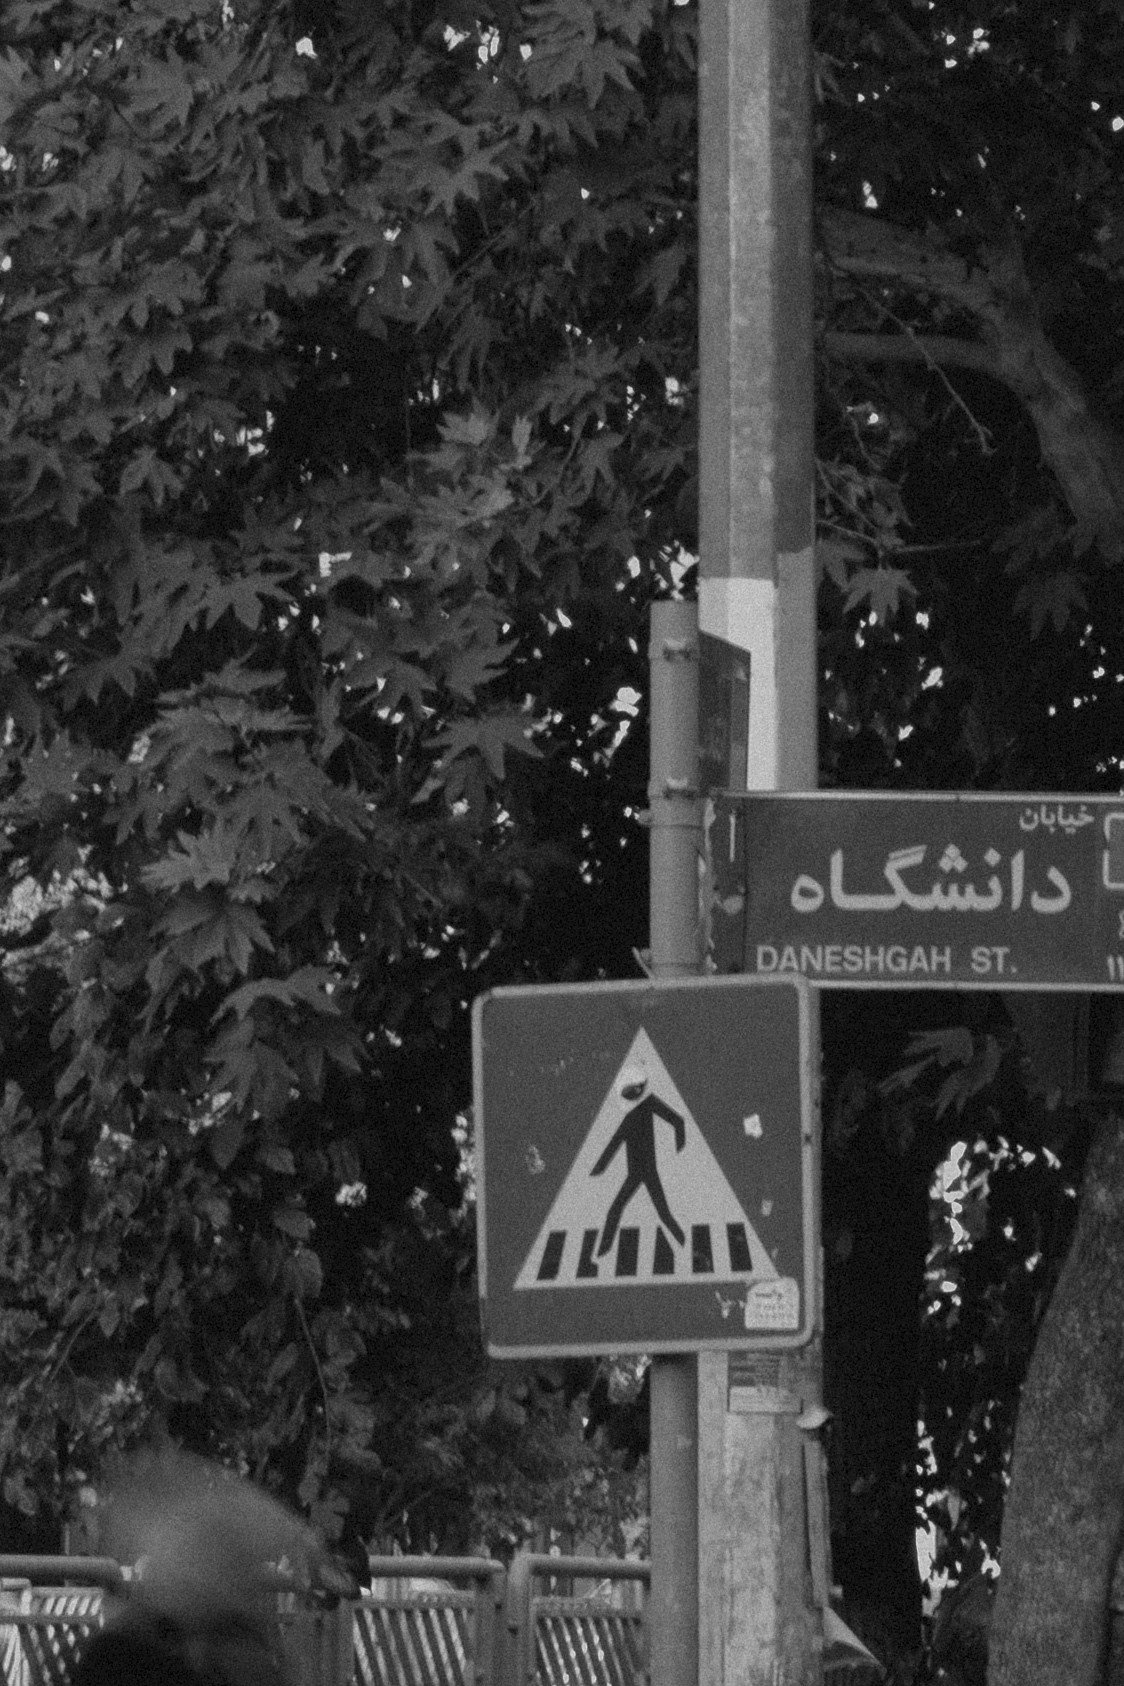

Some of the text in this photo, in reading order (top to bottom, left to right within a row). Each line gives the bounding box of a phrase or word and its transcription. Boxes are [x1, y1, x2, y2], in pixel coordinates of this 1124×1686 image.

[1019, 803, 1095, 835] خیابان
[791, 843, 1071, 914] دانشگاه
[756, 944, 1018, 974] DANESHGAH ST.
[1106, 953, 1124, 982] ۱۱
